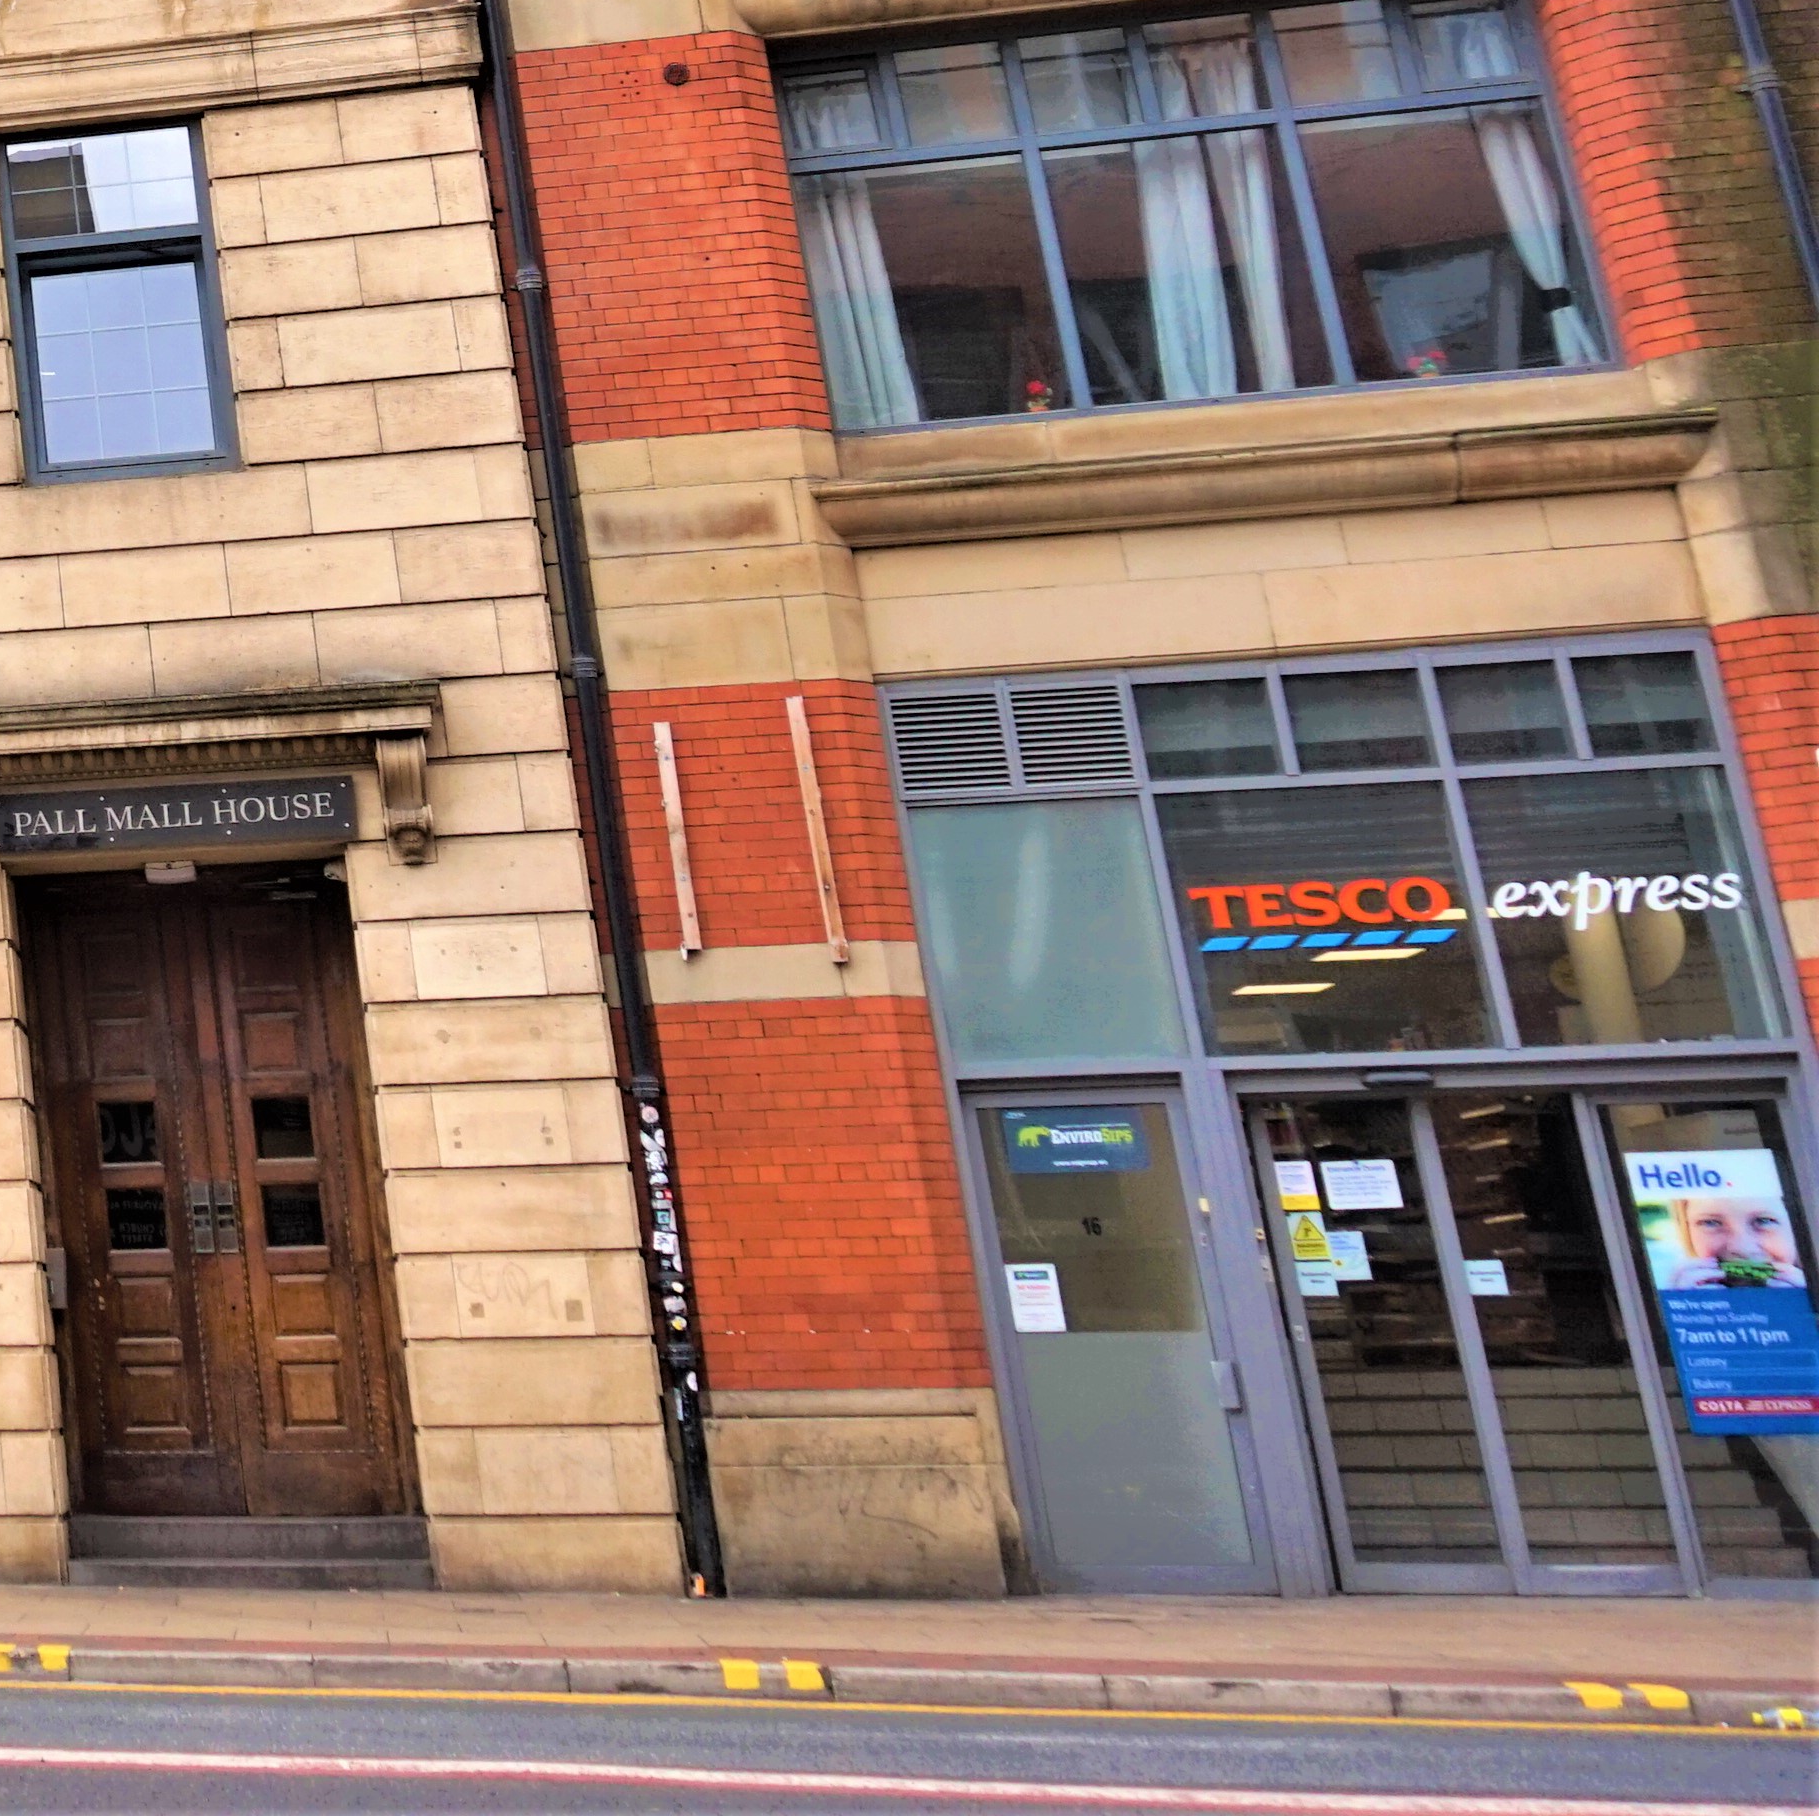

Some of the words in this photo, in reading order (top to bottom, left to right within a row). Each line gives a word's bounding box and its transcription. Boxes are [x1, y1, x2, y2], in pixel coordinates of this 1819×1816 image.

[14, 807, 98, 837] PALL
[105, 800, 203, 832] MALL
[212, 791, 335, 825] HOUSE
[1187, 876, 1451, 929] TESCO
[1493, 869, 1744, 932] express
[1639, 1162, 1733, 1189] Hello.
[1082, 1216, 1103, 1236] 16
[1675, 1327, 1715, 1344] 7am
[1717, 1328, 1737, 1344] to
[1737, 1326, 1791, 1347] 11pm
[1696, 1399, 1745, 1413] COSTA
